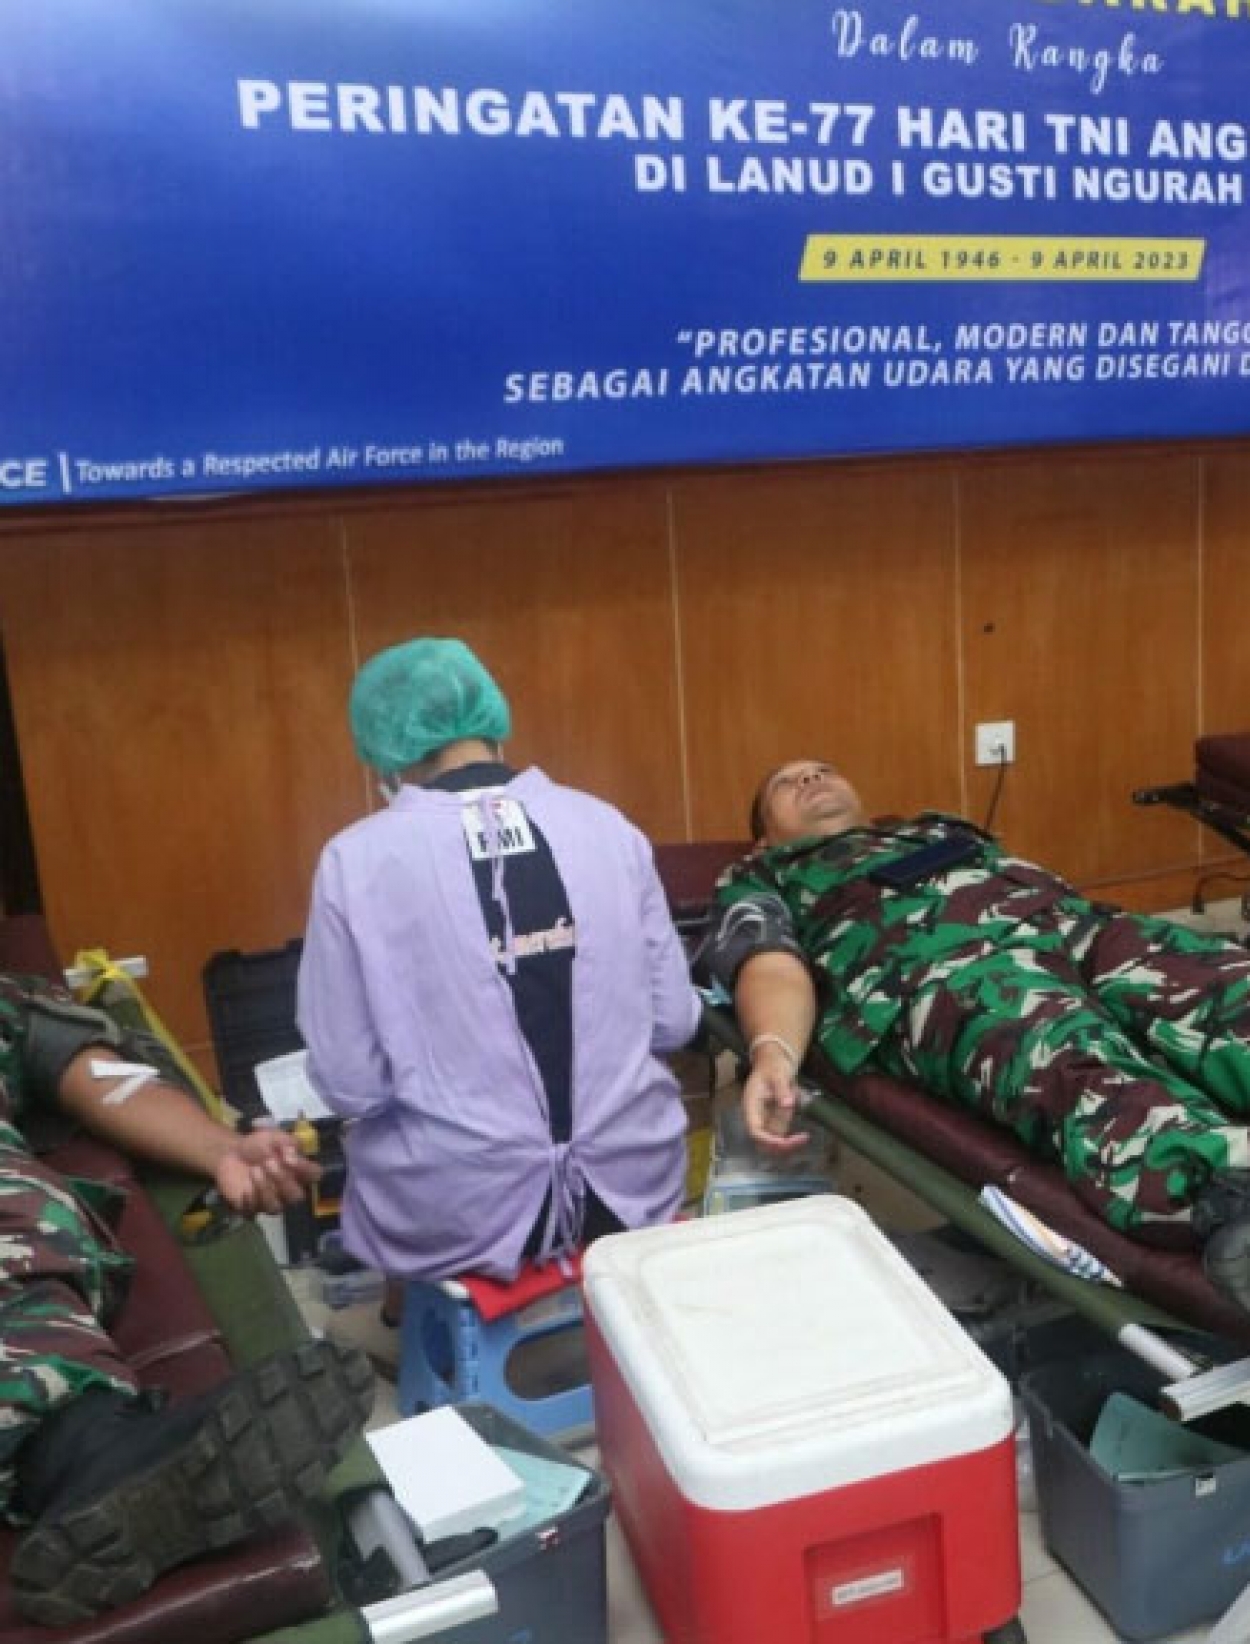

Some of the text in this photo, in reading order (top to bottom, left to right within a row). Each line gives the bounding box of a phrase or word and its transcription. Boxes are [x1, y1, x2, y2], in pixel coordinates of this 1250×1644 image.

[832, 9, 1160, 94] Dalam Rangka
[237, 80, 683, 140] PERINGATAN
[709, 98, 875, 145] KE-77
[898, 106, 1024, 151] HARI
[1044, 114, 1127, 155] TNI
[635, 154, 685, 191] DI
[707, 157, 872, 194] LANUD
[892, 160, 904, 194] I
[924, 163, 1056, 198] GUSTI
[1073, 168, 1241, 203] NGURAH
[823, 248, 840, 270] 9
[849, 248, 926, 270] APRIL
[941, 250, 1002, 270] 1946
[1031, 250, 1046, 270] 9
[1052, 250, 1123, 270] APRIL
[1132, 251, 1189, 270] 2023
[955, 323, 1087, 349] MODERN
[1098, 323, 1159, 346] DAN
[504, 369, 667, 403] SEBAGAI
[681, 363, 870, 394] ANGKATAN
[884, 358, 992, 386] UDARA
[1007, 355, 1084, 381] YANG
[1096, 351, 1230, 380] DISEGANI
[75, 457, 174, 483] Towards
[183, 460, 195, 477] a
[203, 449, 320, 477] Respected
[326, 448, 358, 468] Air
[364, 446, 423, 466] Force
[429, 443, 449, 460] in
[455, 440, 489, 460] the
[495, 437, 563, 460] Region
